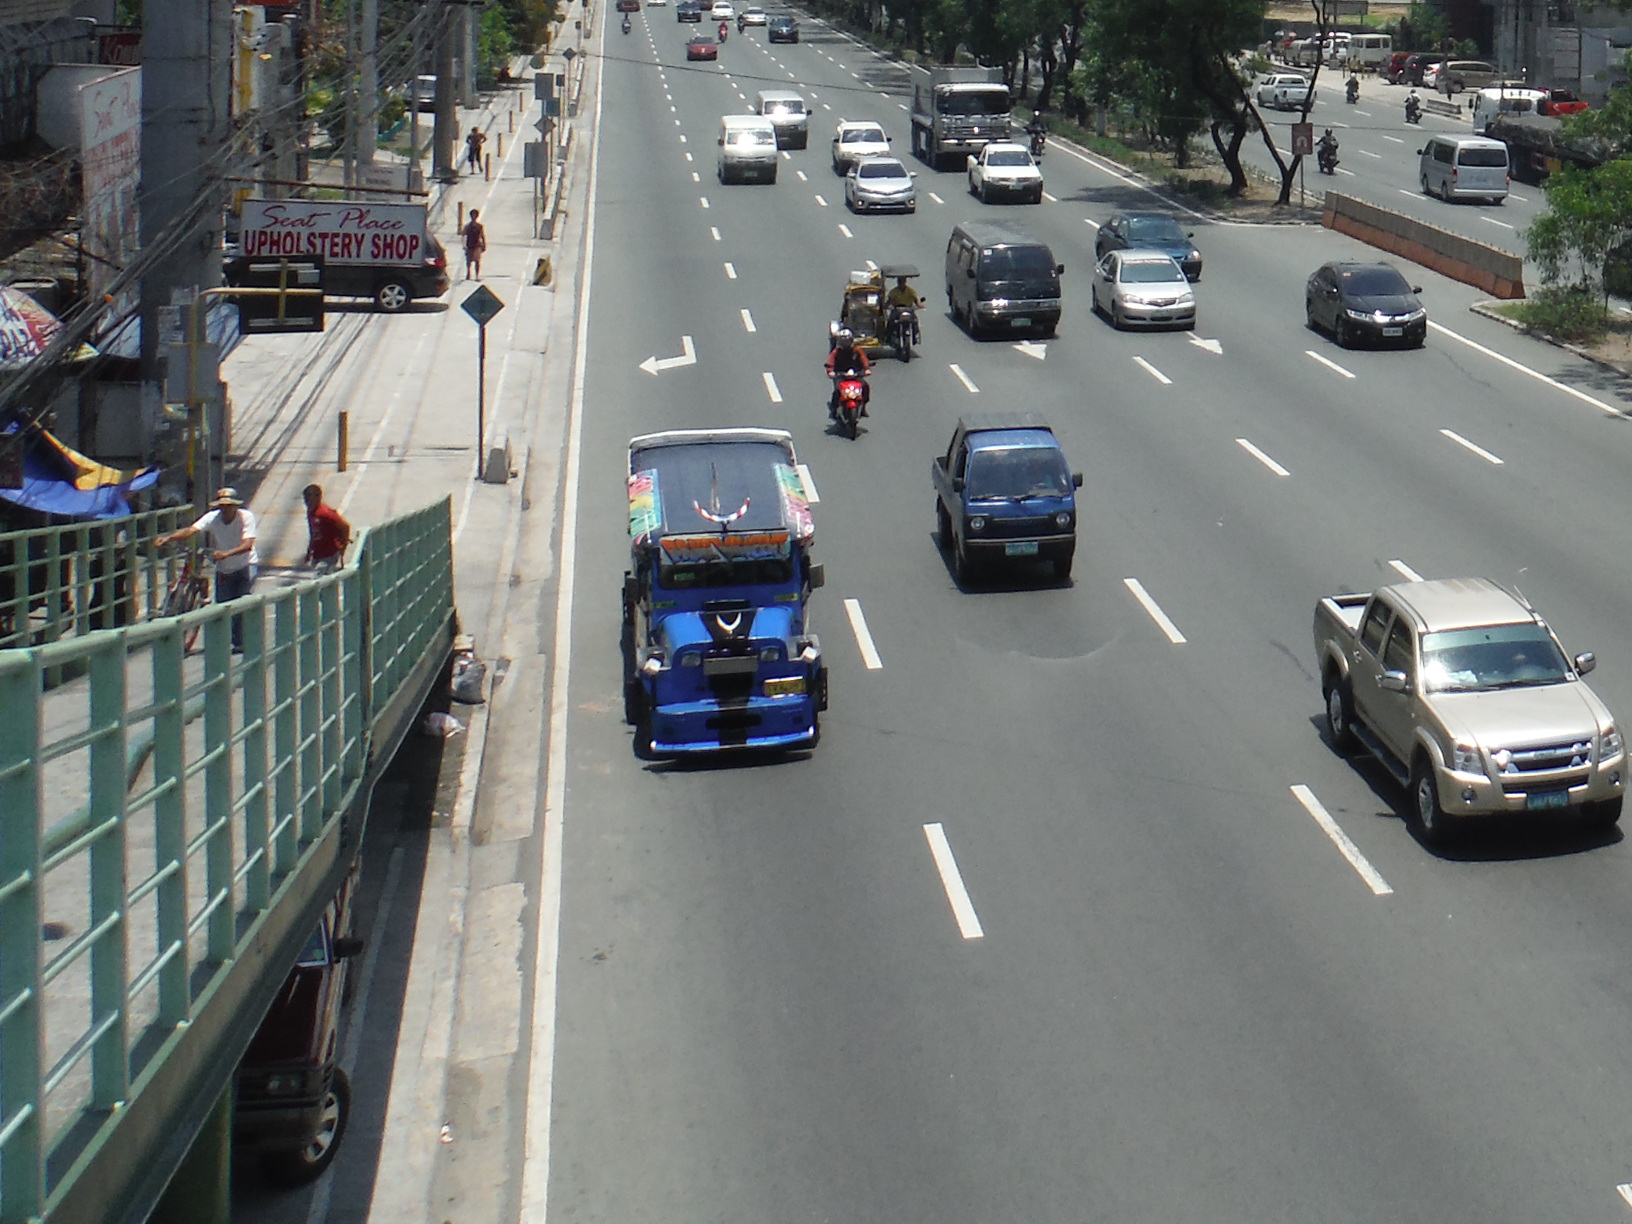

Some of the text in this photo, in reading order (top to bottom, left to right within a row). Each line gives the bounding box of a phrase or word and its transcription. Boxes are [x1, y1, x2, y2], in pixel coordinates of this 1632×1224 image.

[262, 205, 405, 230] Seat Place
[244, 230, 420, 259] UPHOLSTERY SHOP
